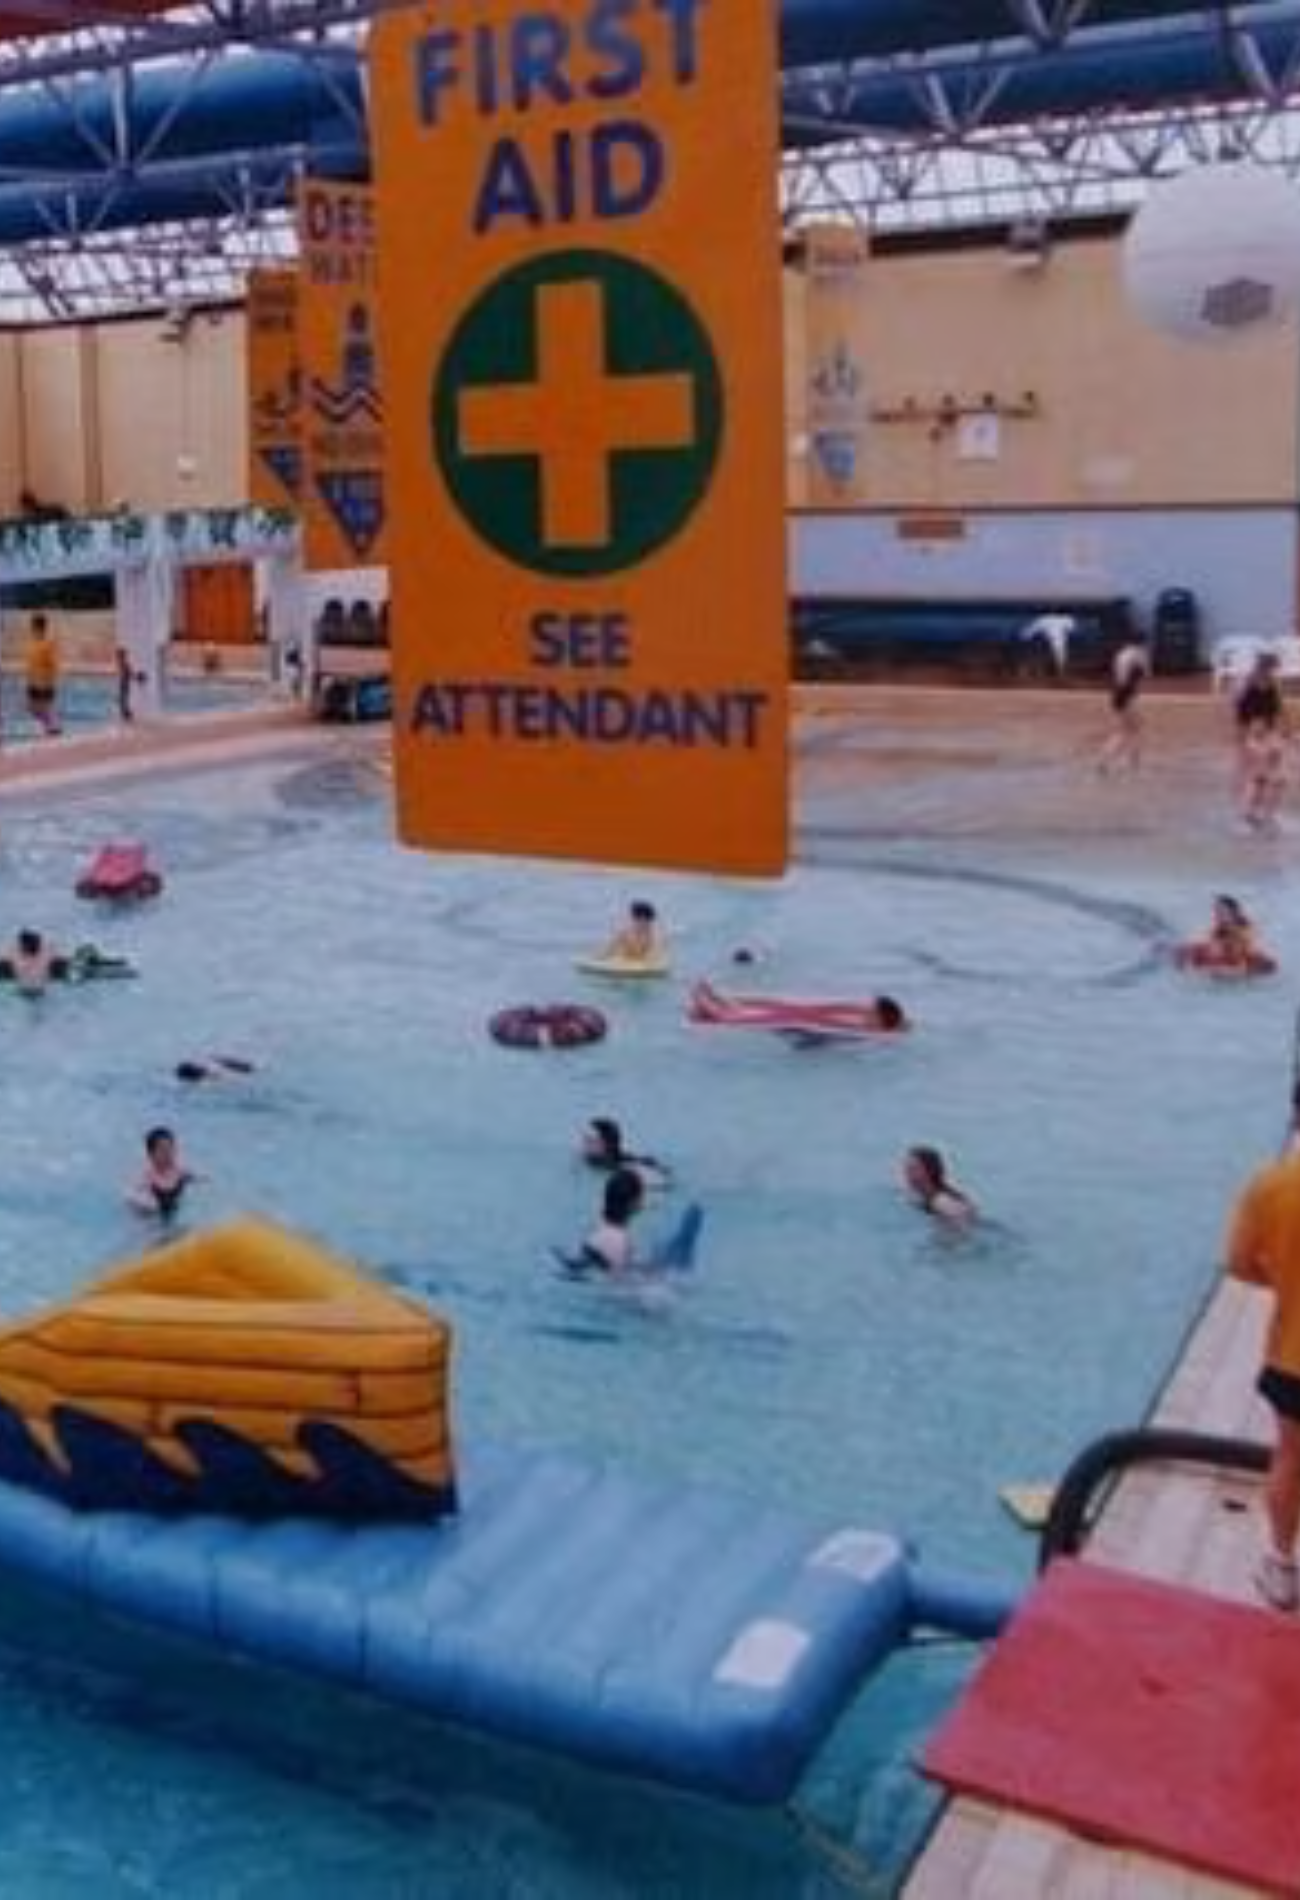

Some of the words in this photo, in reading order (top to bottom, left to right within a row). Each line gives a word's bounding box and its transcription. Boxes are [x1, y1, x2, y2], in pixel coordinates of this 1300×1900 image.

[416, 0, 702, 127] FIRST
[473, 120, 665, 235] AID
[307, 190, 378, 246] DEE
[530, 612, 630, 668] SEE
[410, 686, 767, 748] ATTENDANT
